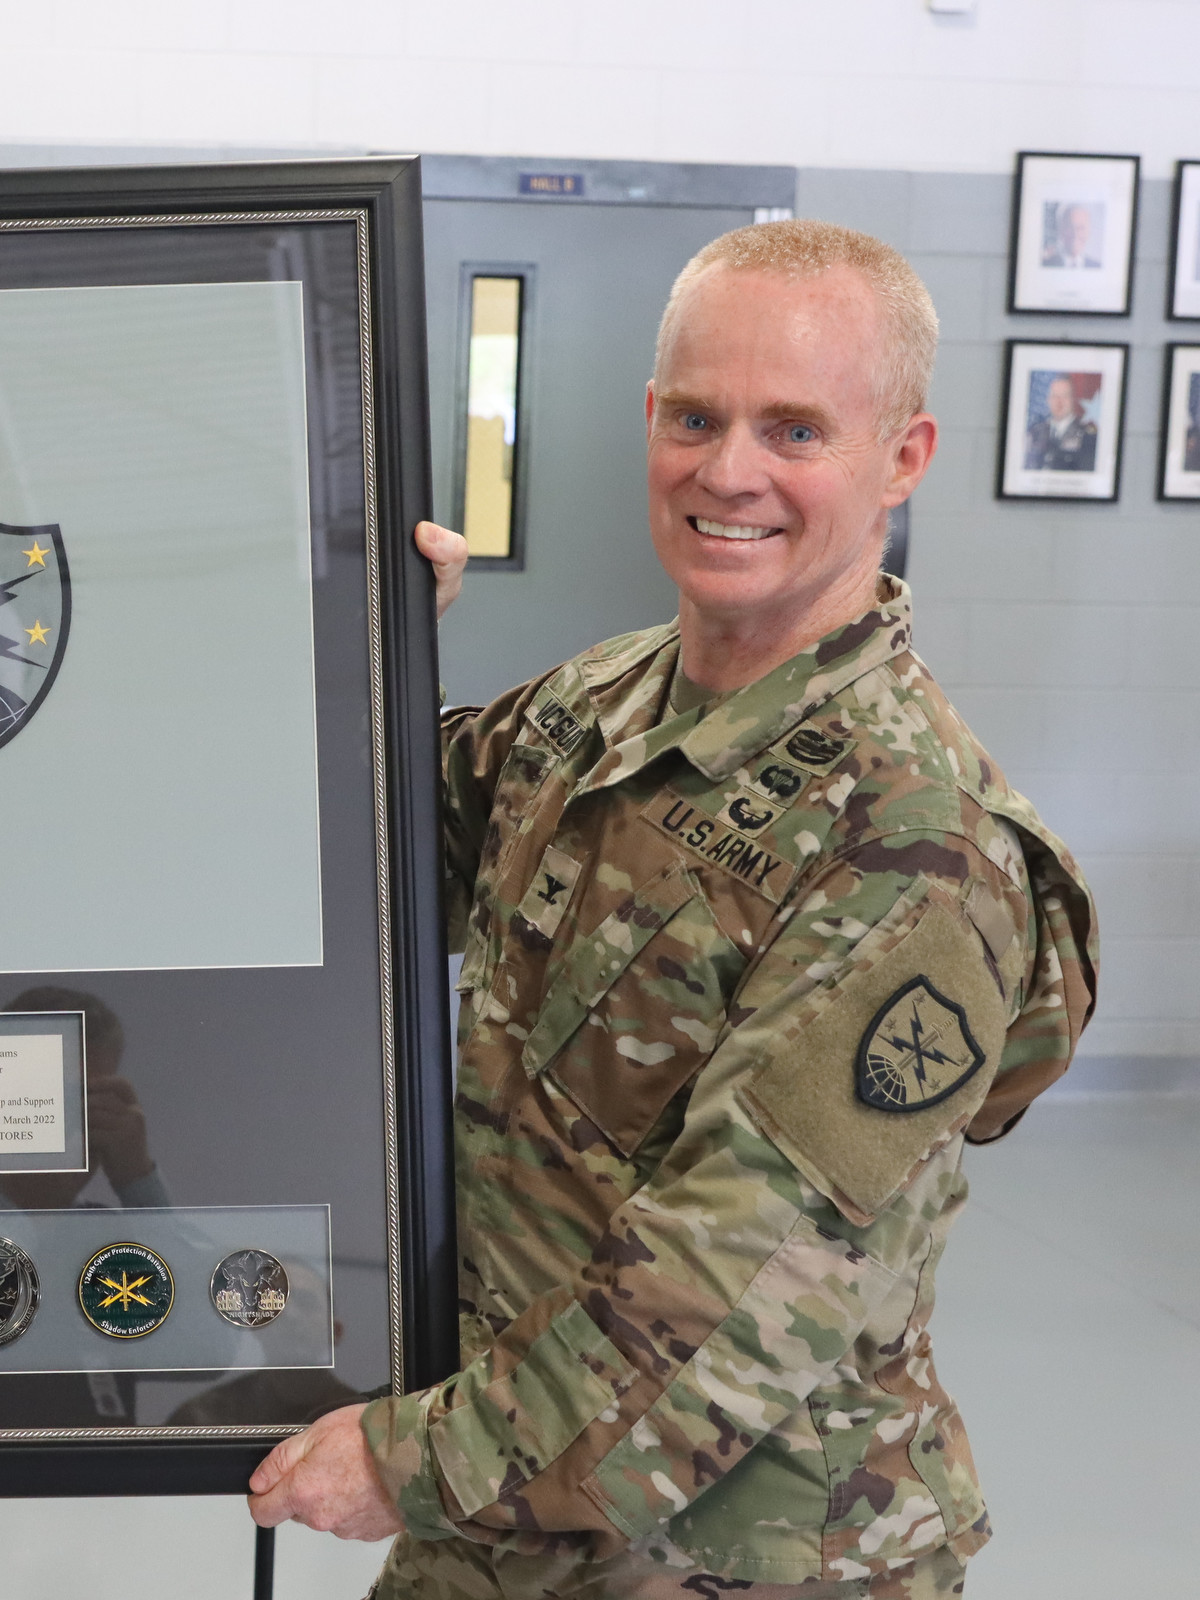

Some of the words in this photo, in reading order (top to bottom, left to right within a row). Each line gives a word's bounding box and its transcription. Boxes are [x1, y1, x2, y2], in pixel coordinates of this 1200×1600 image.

[7, 1097, 22, 1106] and
[23, 1096, 54, 1108] Support
[3, 1114, 31, 1125] March
[33, 1114, 55, 1124] 2022
[93, 1252, 111, 1268] Cyber
[111, 1246, 146, 1258] Protection
[146, 1253, 168, 1281] Battalion
[100, 1320, 127, 1334] Shadow
[128, 1319, 156, 1334] Enforcer
